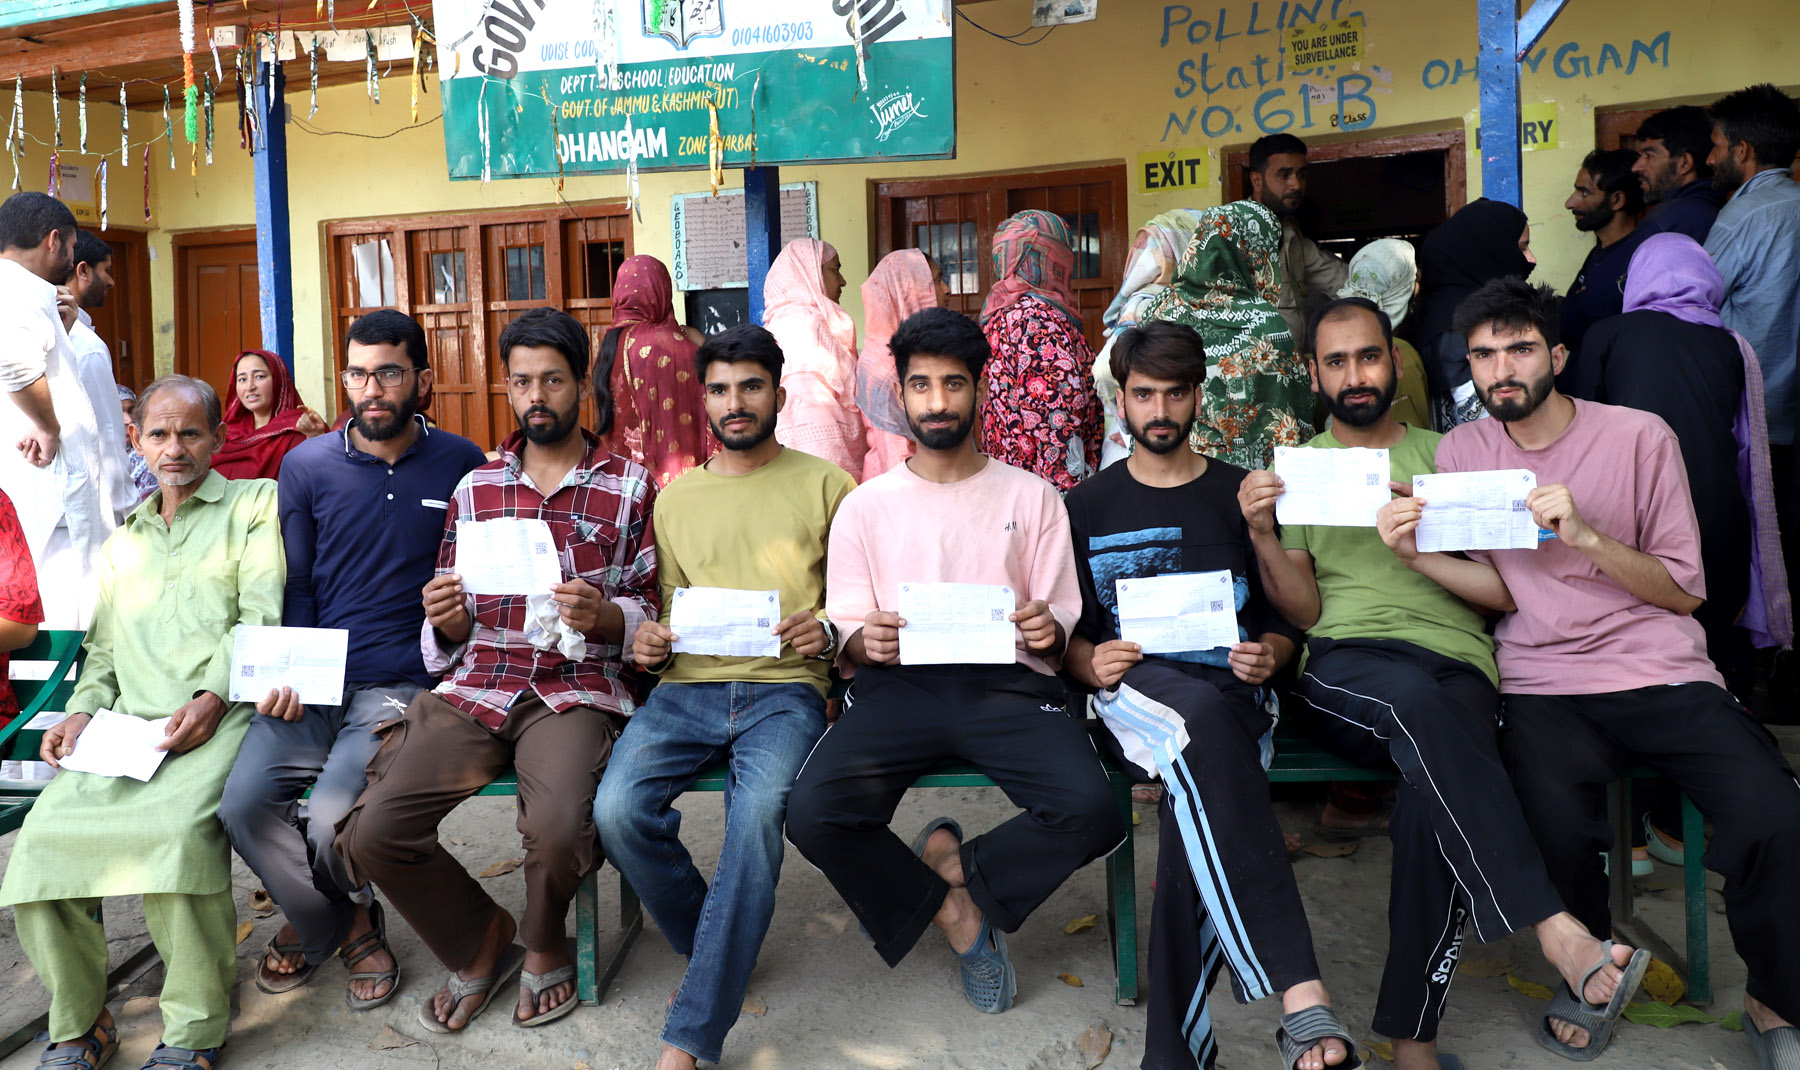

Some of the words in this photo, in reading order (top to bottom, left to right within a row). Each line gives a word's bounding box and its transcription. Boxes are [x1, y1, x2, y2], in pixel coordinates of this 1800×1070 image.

[732, 21, 813, 46] 01041603903
[1292, 39, 1308, 52] YOU
[1311, 36, 1327, 49] ARE
[1329, 31, 1358, 46] UNDER
[541, 41, 569, 62] UDISE
[1295, 45, 1357, 66] SURVEILLANCE
[617, 69, 663, 91] SCHOOL
[668, 63, 735, 86] EDUCATION
[593, 97, 608, 118] OF
[610, 94, 650, 117] JAMMU
[652, 94, 663, 114] &
[678, 136, 708, 157] ZONE
[1145, 158, 1201, 189] EXIT
[674, 202, 684, 281] GEOBOARD
